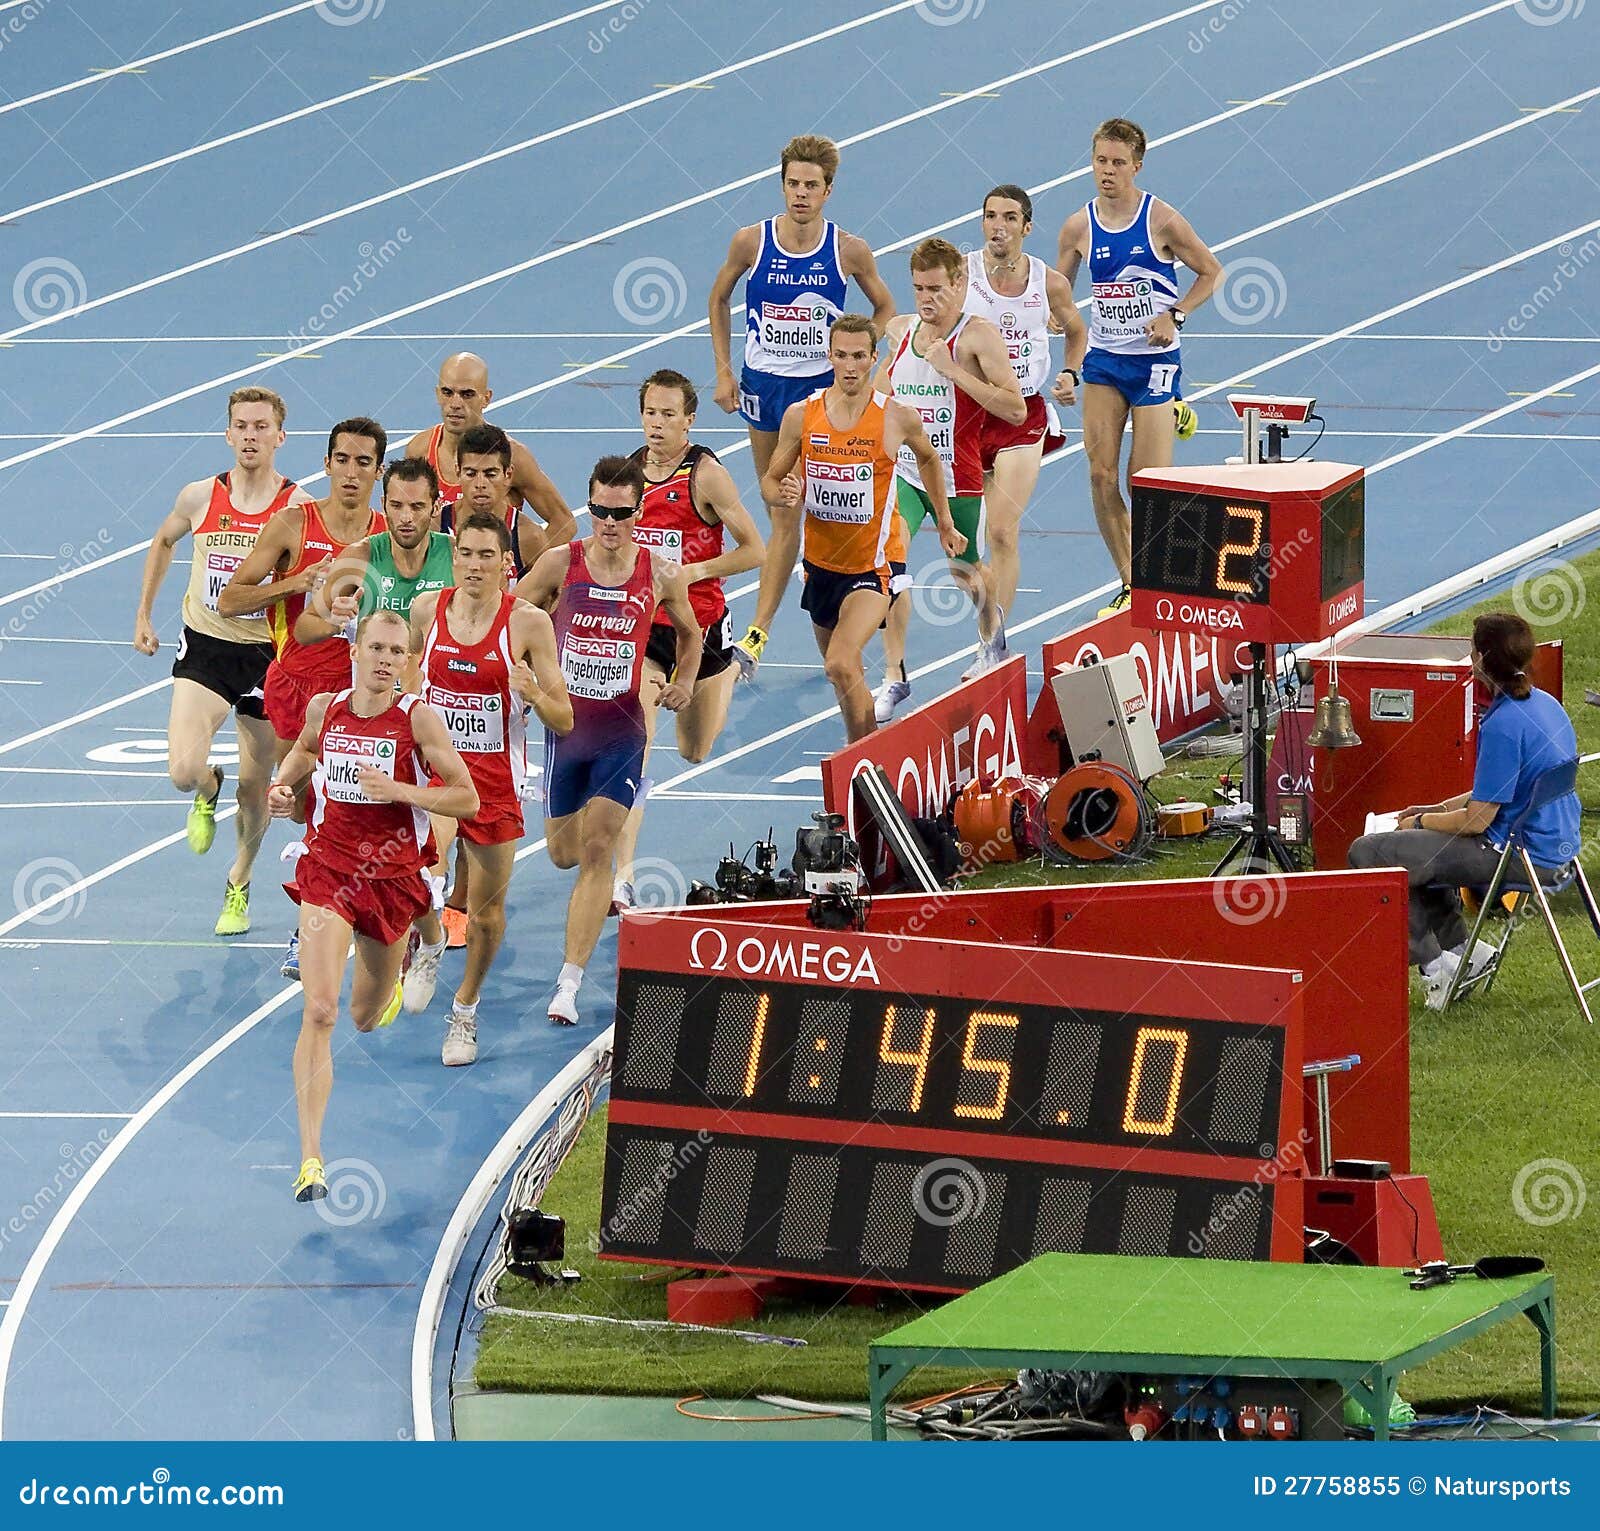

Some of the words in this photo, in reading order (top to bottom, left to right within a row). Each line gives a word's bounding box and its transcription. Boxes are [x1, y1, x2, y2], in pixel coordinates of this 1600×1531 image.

[767, 273, 828, 286] FINLAND
[970, 281, 995, 306] Reebok
[1093, 285, 1134, 298] SPAR
[764, 304, 810, 320] SPAR
[1098, 297, 1153, 324] Bergdahl
[765, 323, 824, 346] Sandells
[809, 350, 826, 359] 2010
[812, 445, 869, 457] NEDERLAND
[807, 463, 854, 480] SPAR
[812, 483, 866, 508] Verwer
[206, 533, 256, 547] DEUTSCH
[1216, 505, 1263, 594] 2
[1178, 604, 1244, 630] OMEGA
[1336, 594, 1358, 621] OMEGA
[571, 612, 637, 635] norway
[434, 644, 460, 654] AUSTRIA
[566, 639, 616, 657] SPAR
[447, 659, 477, 673] Škoda
[565, 653, 629, 686] Ingebrigtsen
[431, 690, 482, 709] SPAR
[567, 682, 608, 698] ARCELONA
[330, 725, 347, 733] LAT
[444, 710, 486, 737] Vojta
[324, 735, 374, 755] SPAR
[483, 742, 502, 751] 2010
[897, 697, 1023, 819] OMEGA
[736, 937, 881, 985] OMEGA
